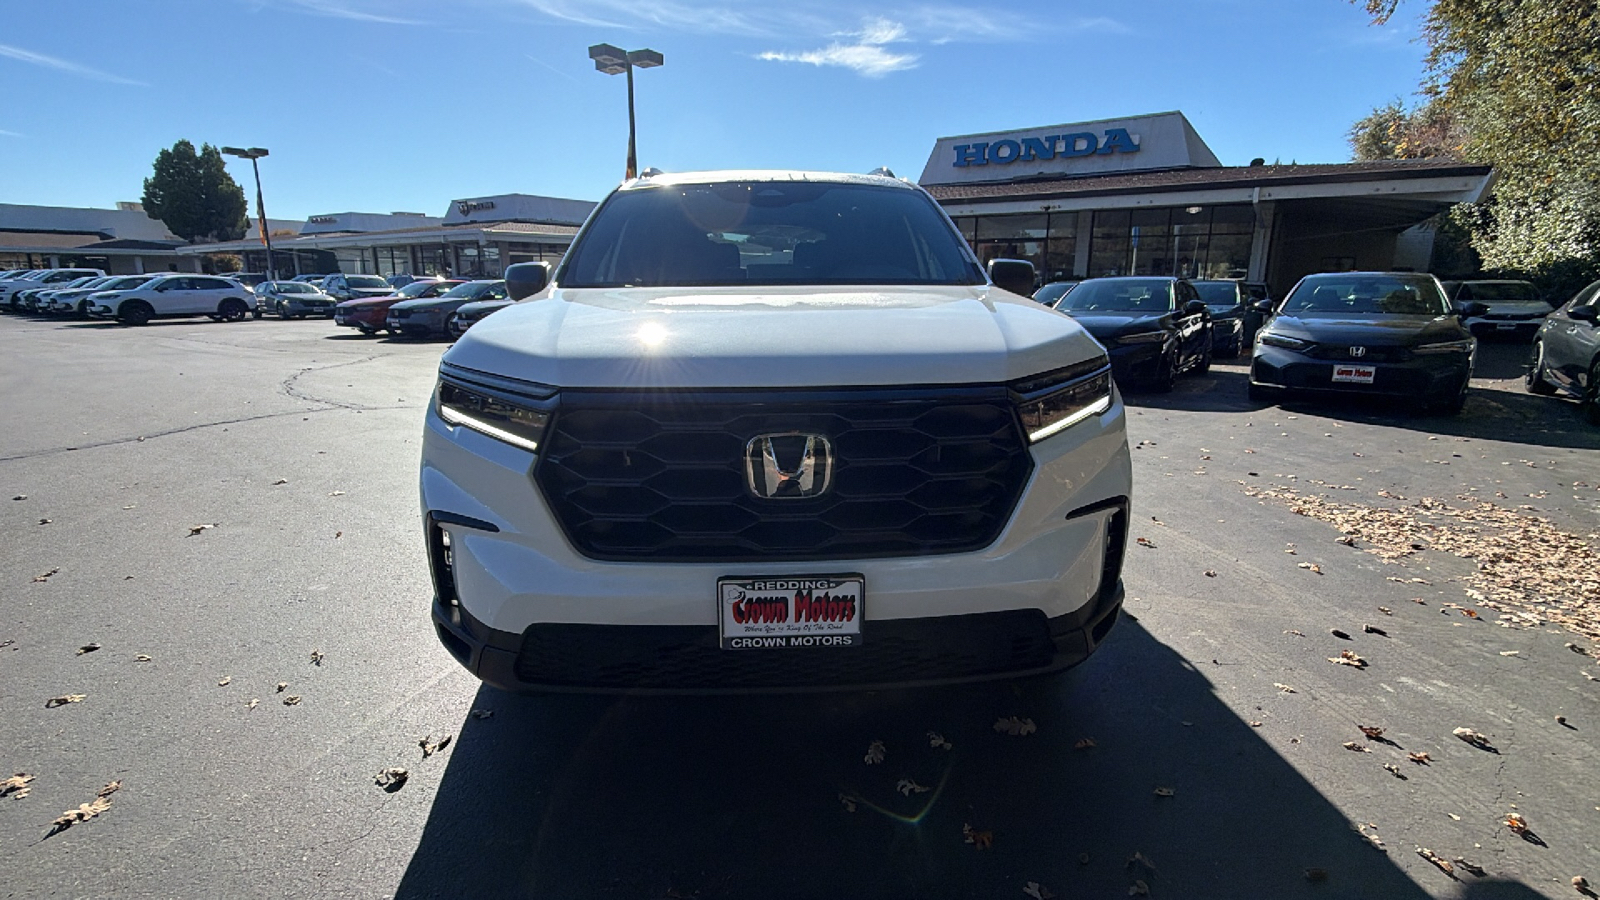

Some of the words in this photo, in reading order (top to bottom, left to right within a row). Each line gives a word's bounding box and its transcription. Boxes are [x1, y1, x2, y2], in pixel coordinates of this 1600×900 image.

[953, 128, 1141, 167] HONDA
[754, 580, 828, 590] REDDING
[732, 592, 789, 624] Crown
[794, 589, 856, 623] Motors
[744, 625, 763, 633] Where
[786, 624, 801, 632] King
[803, 624, 812, 632] Of
[813, 623, 824, 631] The
[826, 623, 844, 631] Road
[731, 637, 786, 648] CROWN
[790, 635, 852, 647] MOTORS
